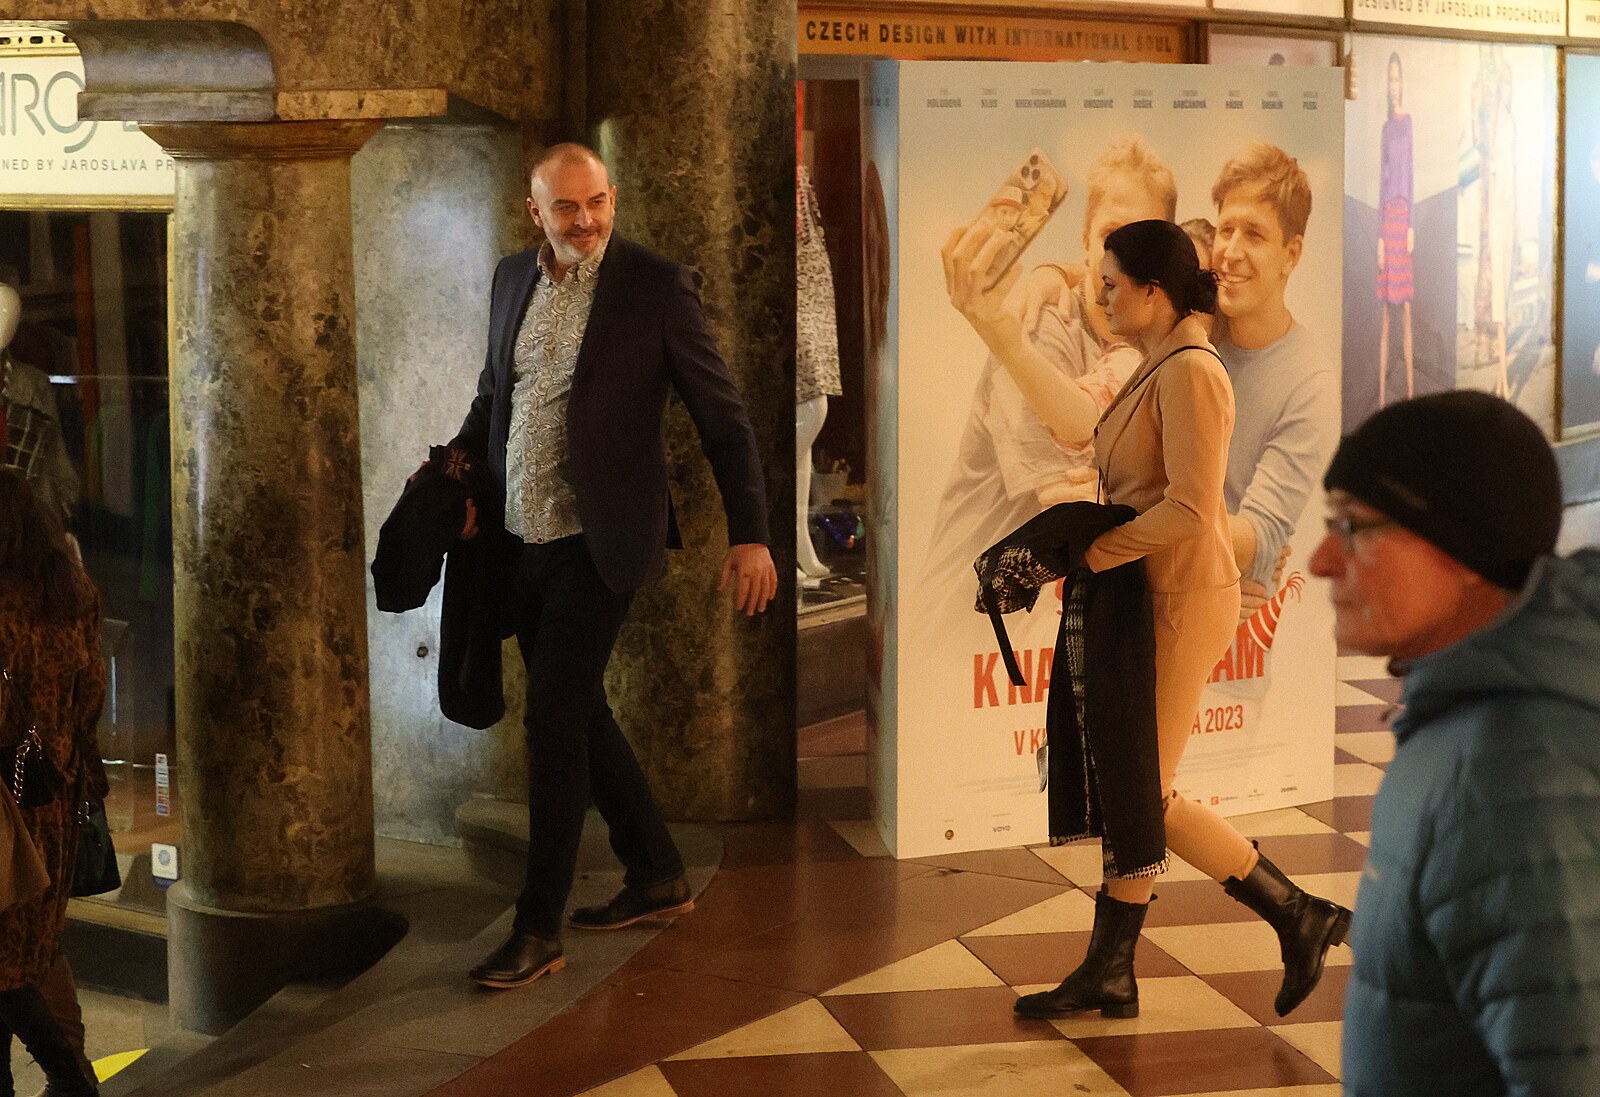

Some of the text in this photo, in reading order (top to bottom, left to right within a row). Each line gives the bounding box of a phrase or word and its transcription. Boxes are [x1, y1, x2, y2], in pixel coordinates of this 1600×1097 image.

[1418, 2, 1430, 13] BY
[806, 20, 1172, 53] CZECH DESIGN WITH INTERNATIONAL SOUL
[37, 159, 54, 171] BY
[62, 159, 148, 171] JAROSLAVA
[973, 651, 1000, 709] K
[1014, 730, 1025, 755] V
[1205, 704, 1244, 733] 2023
